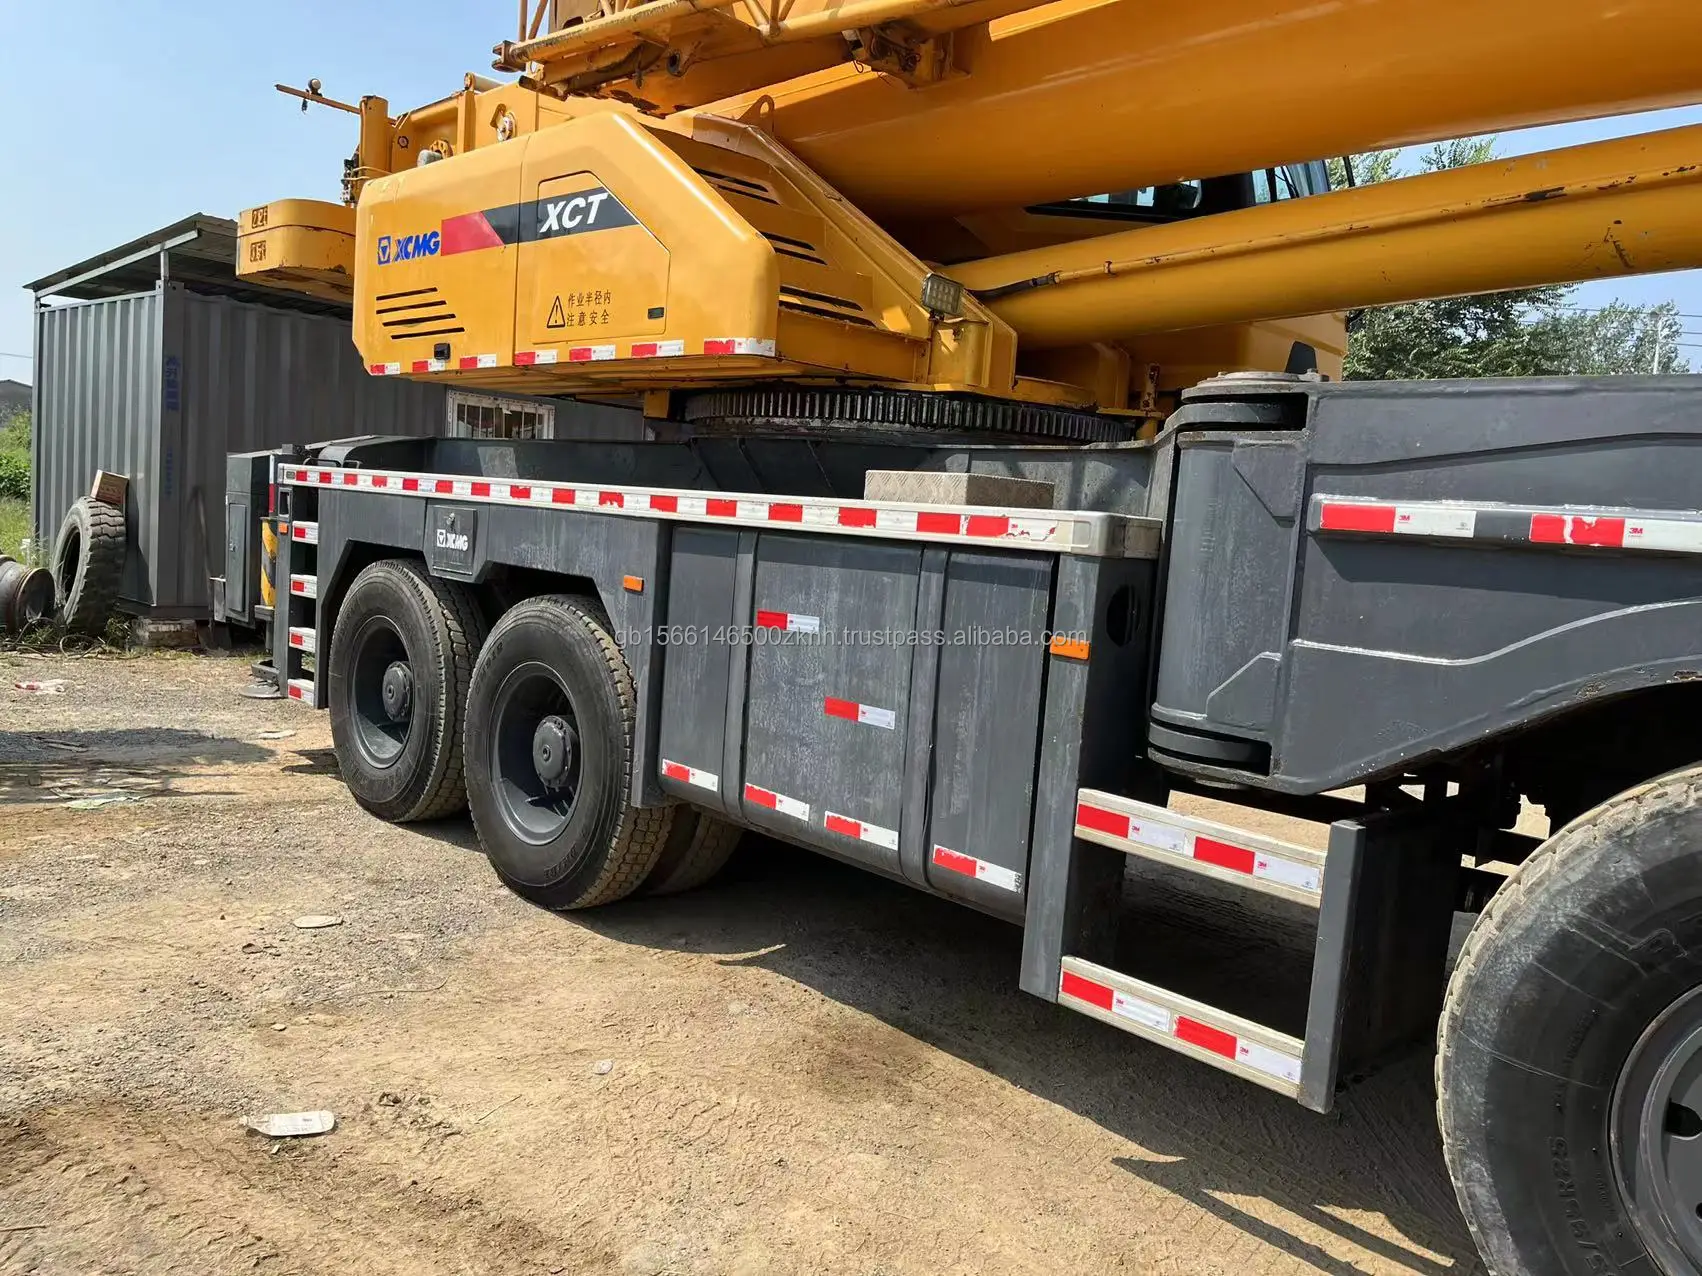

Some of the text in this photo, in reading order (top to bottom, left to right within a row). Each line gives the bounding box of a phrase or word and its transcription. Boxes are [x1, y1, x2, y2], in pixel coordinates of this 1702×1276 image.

[539, 193, 608, 233] XCT
[394, 231, 440, 261] XCMG
[568, 290, 611, 307] 作业半径内
[567, 309, 609, 326] 注意安全
[446, 533, 468, 551] XCMG
